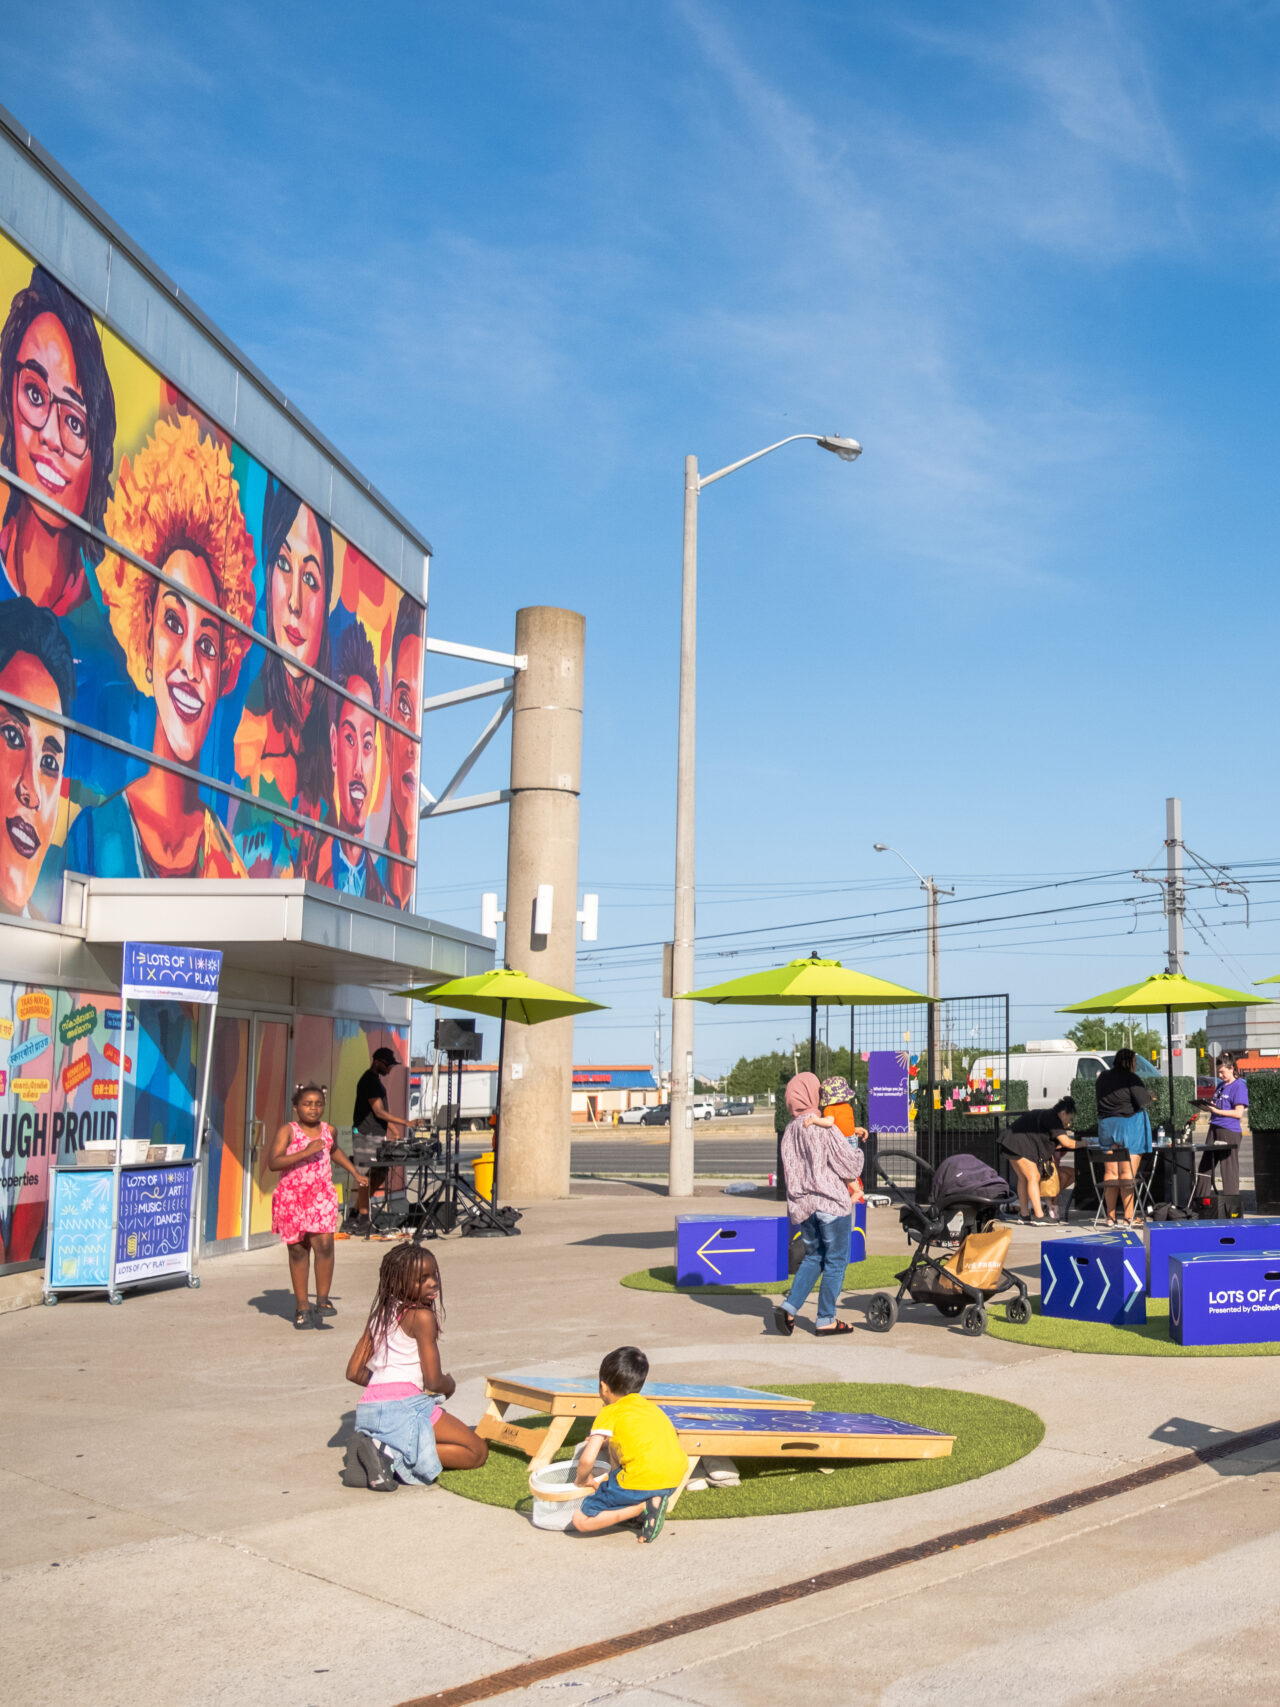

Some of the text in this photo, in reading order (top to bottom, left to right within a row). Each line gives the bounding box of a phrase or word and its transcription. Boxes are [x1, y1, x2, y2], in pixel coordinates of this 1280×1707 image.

[147, 953, 185, 967] LOTS OF
[194, 972, 217, 986] PLAY
[51, 1110, 118, 1155] PROUD
[126, 1174, 157, 1188] LOTS OF
[168, 1185, 181, 1197] ART
[138, 1201, 162, 1214] MUSIC
[156, 1212, 180, 1226] DANCE
[1209, 1290, 1244, 1304] LOTS
[1247, 1289, 1267, 1302] OF
[1209, 1306, 1241, 1314] Presented
